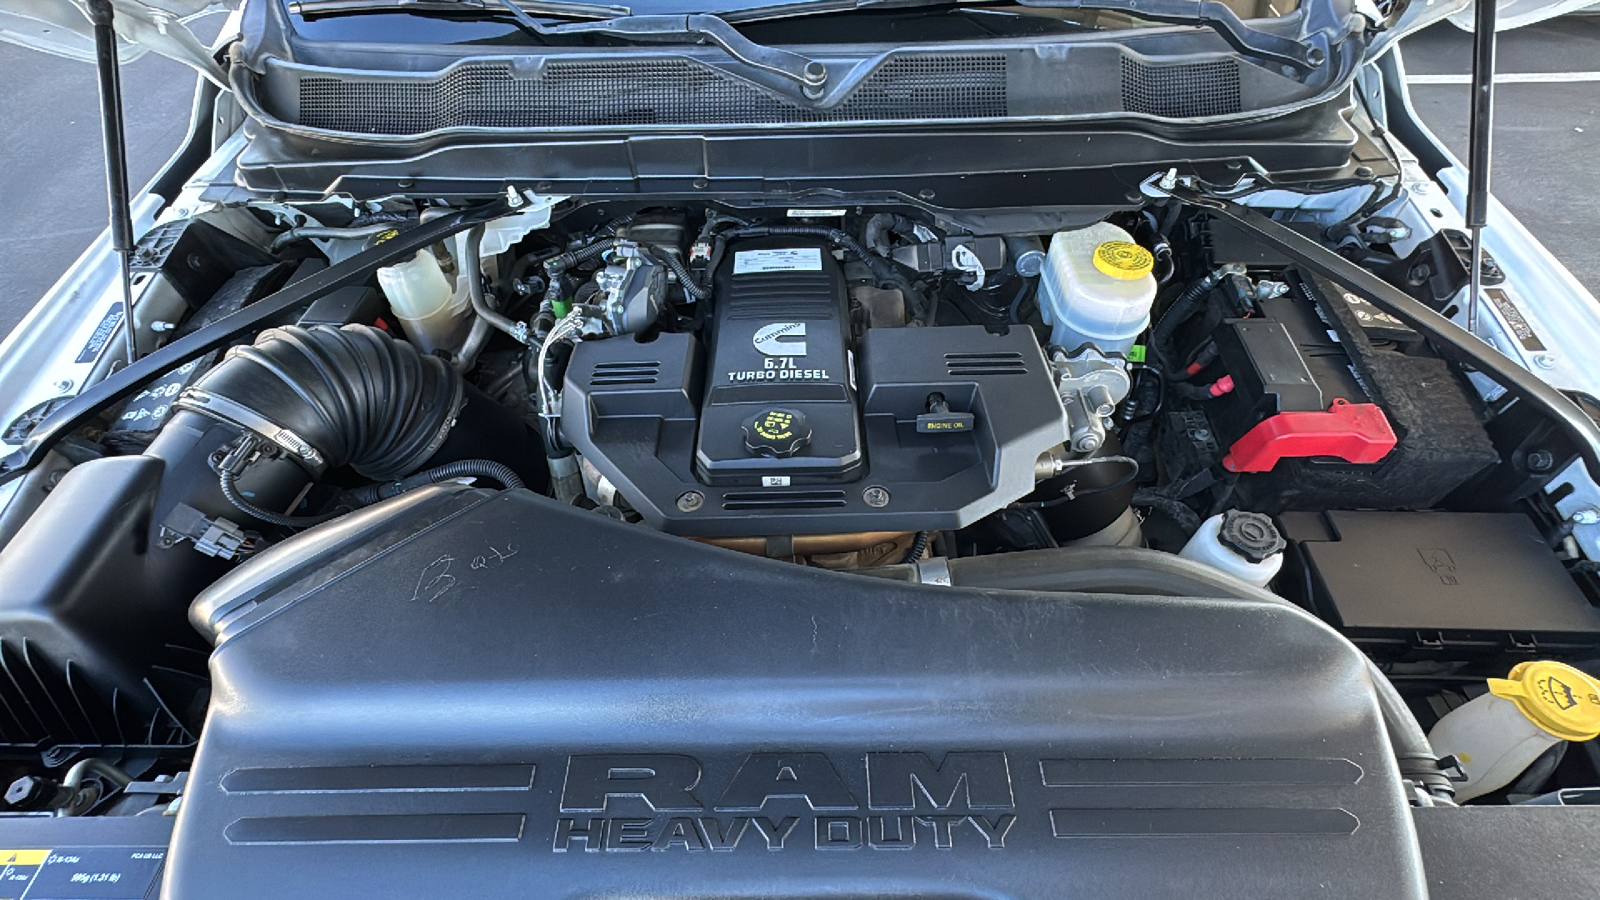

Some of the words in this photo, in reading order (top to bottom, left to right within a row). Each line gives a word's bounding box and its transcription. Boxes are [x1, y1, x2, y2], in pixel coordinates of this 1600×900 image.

[755, 322, 801, 344] Cummins
[764, 357, 797, 369] 6.7L
[727, 370, 776, 381] TURBO
[779, 369, 829, 379] DIESEL
[560, 751, 1016, 812] RAM
[553, 817, 800, 852] HEAVY
[814, 815, 1017, 851] DUTY
